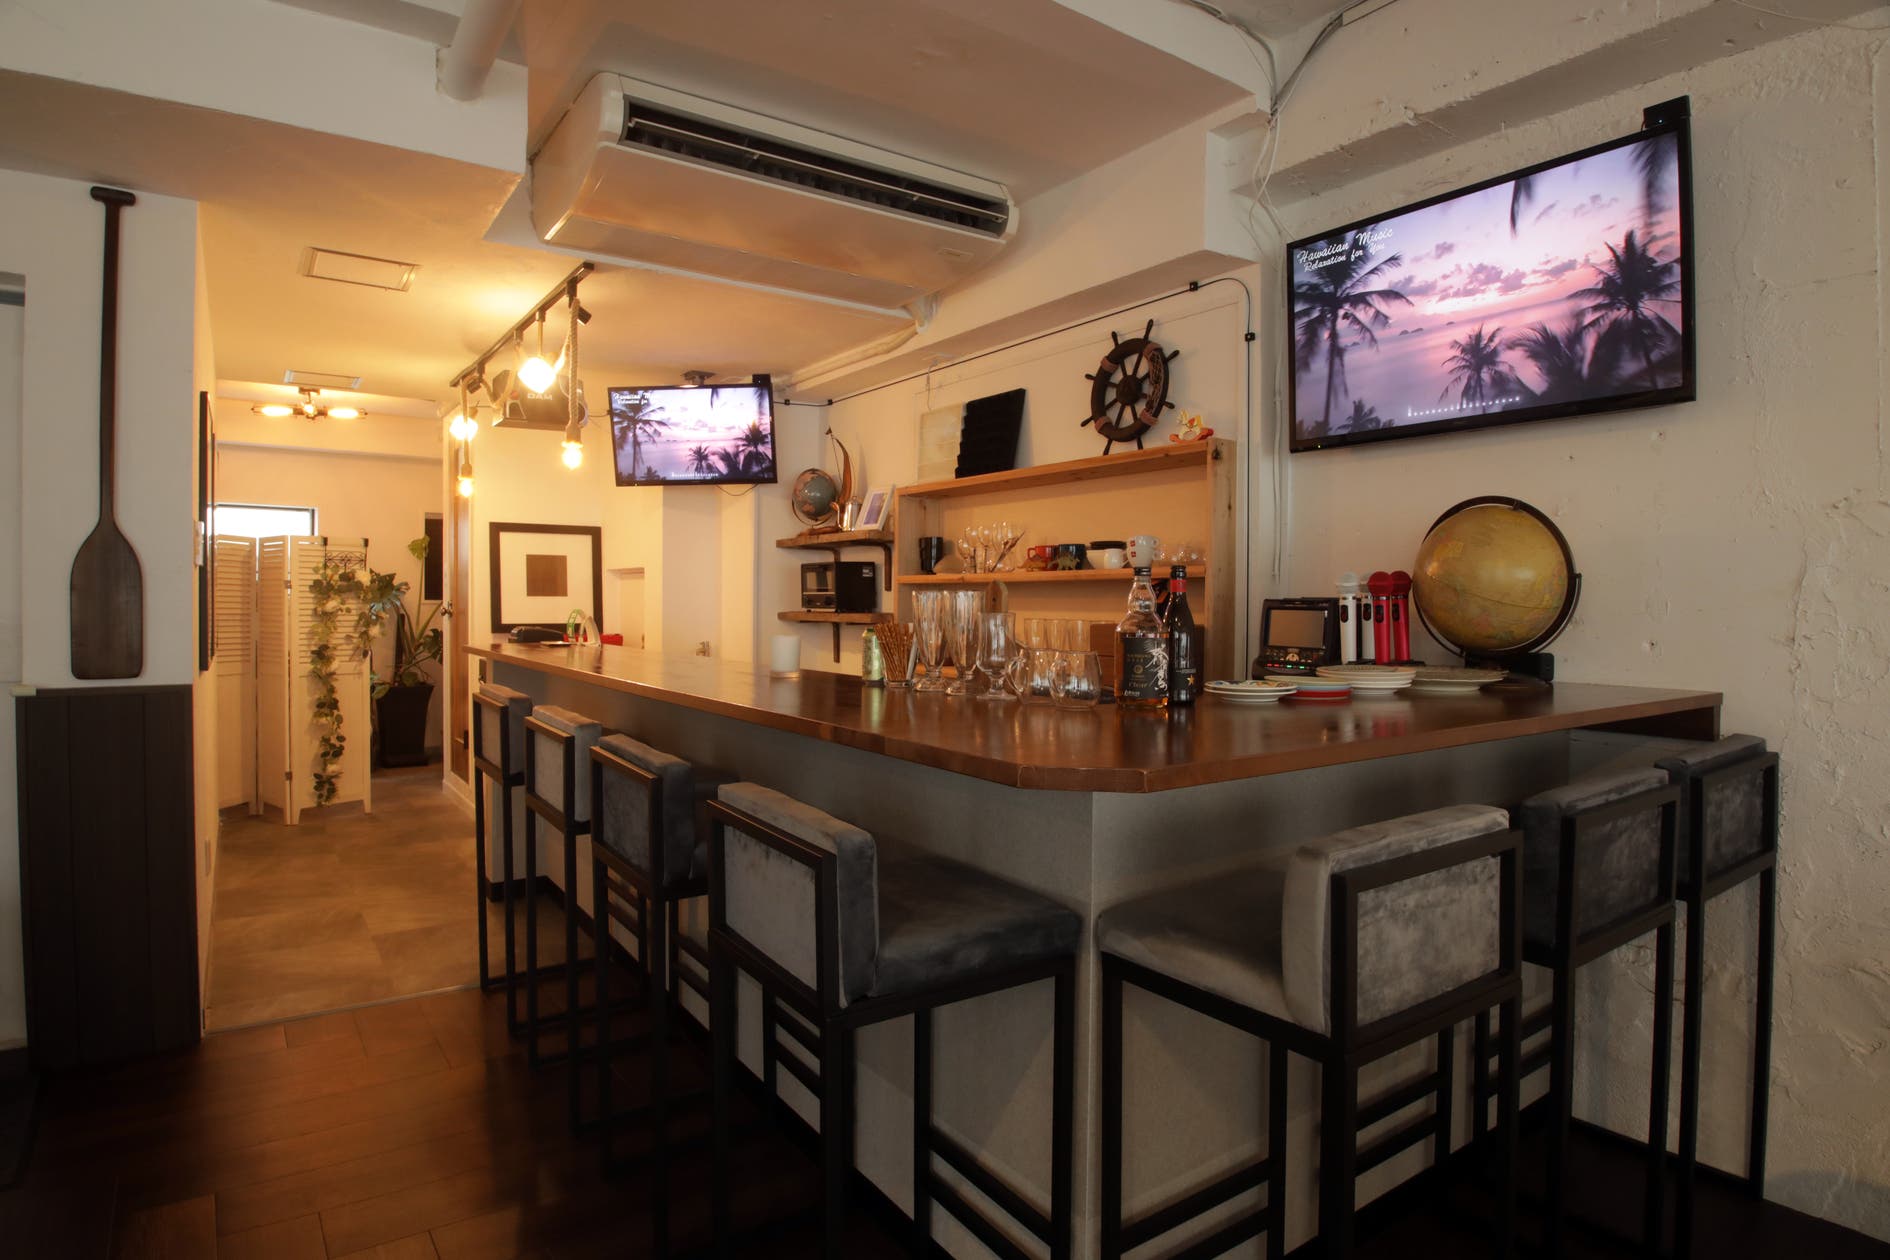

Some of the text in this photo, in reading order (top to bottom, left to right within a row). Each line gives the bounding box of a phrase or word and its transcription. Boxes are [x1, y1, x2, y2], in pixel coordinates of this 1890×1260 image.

[1297, 228, 1393, 263] Hawaiian Music
[1303, 243, 1385, 272] Relaxation for You
